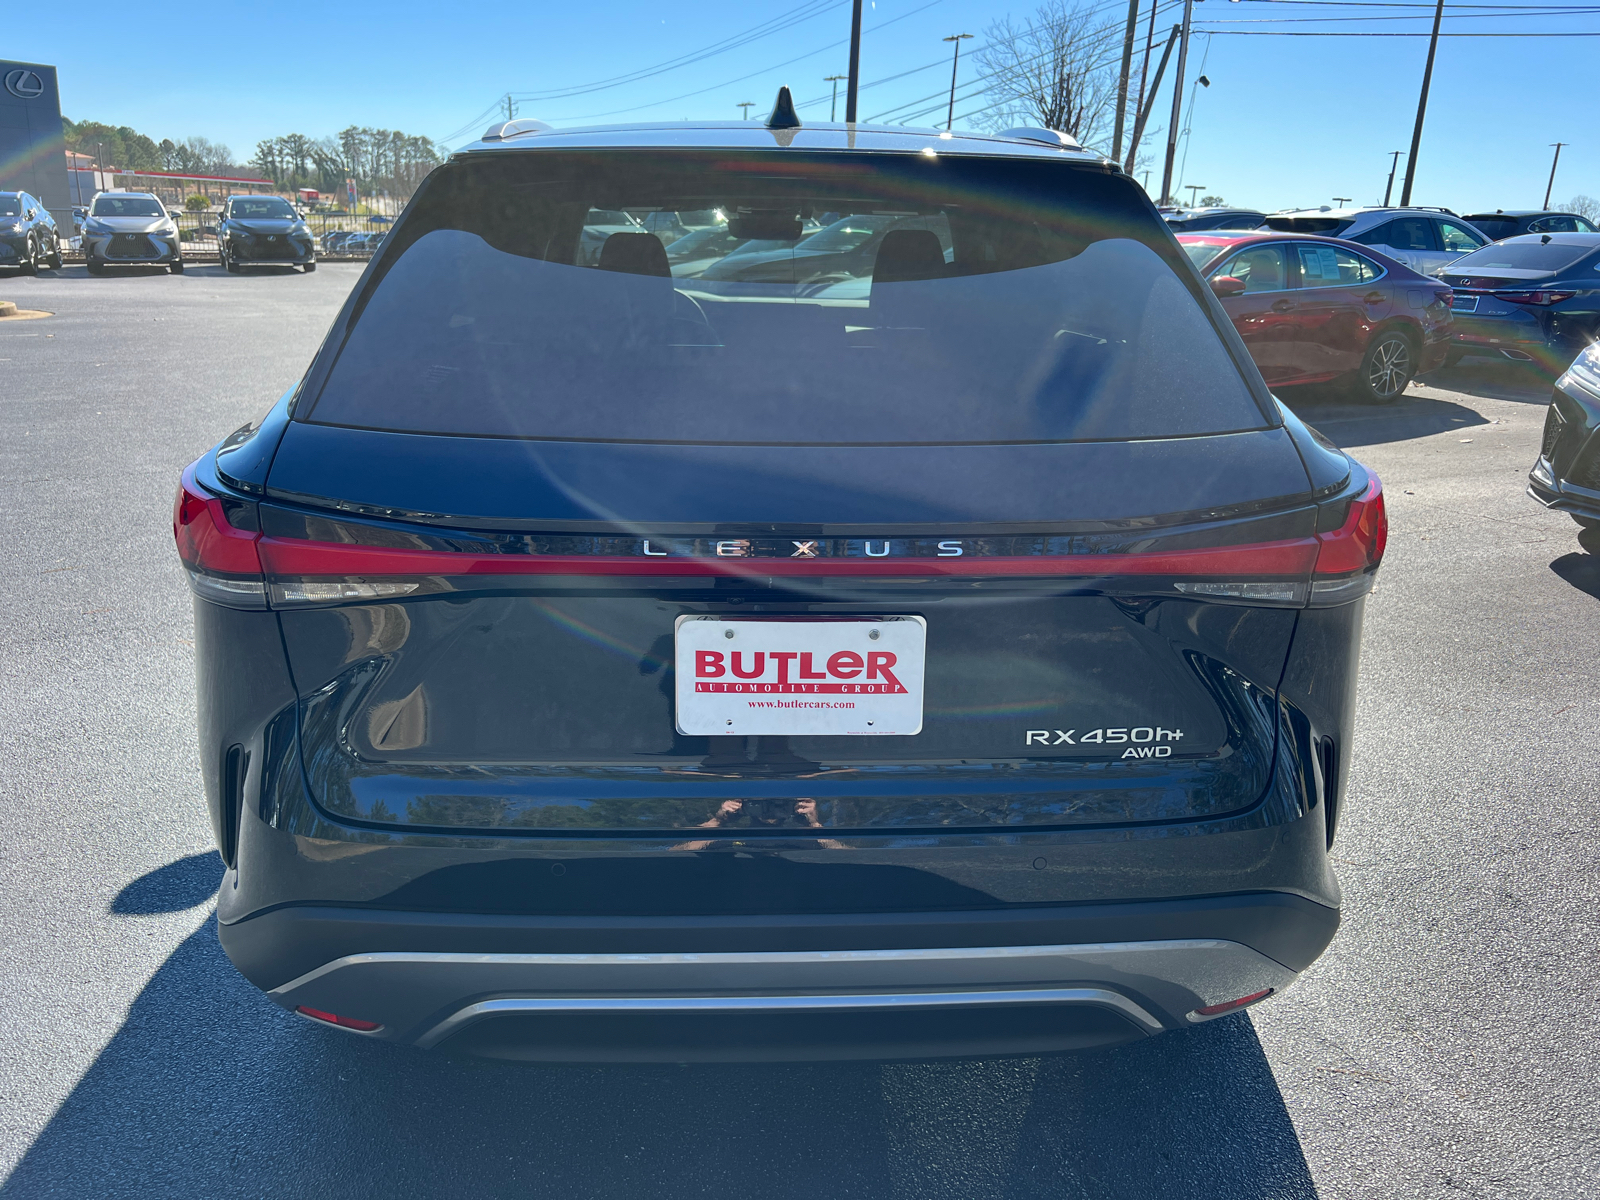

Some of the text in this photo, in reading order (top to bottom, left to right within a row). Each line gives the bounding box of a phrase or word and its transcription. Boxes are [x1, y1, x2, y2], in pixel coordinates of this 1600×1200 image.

[643, 540, 964, 557] LEXUS
[696, 683, 901, 693] AUTOMOTIVE GROUP
[748, 699, 855, 709] www.butlercars.com
[1026, 729, 1076, 745] RX
[1121, 746, 1173, 759] AWD
